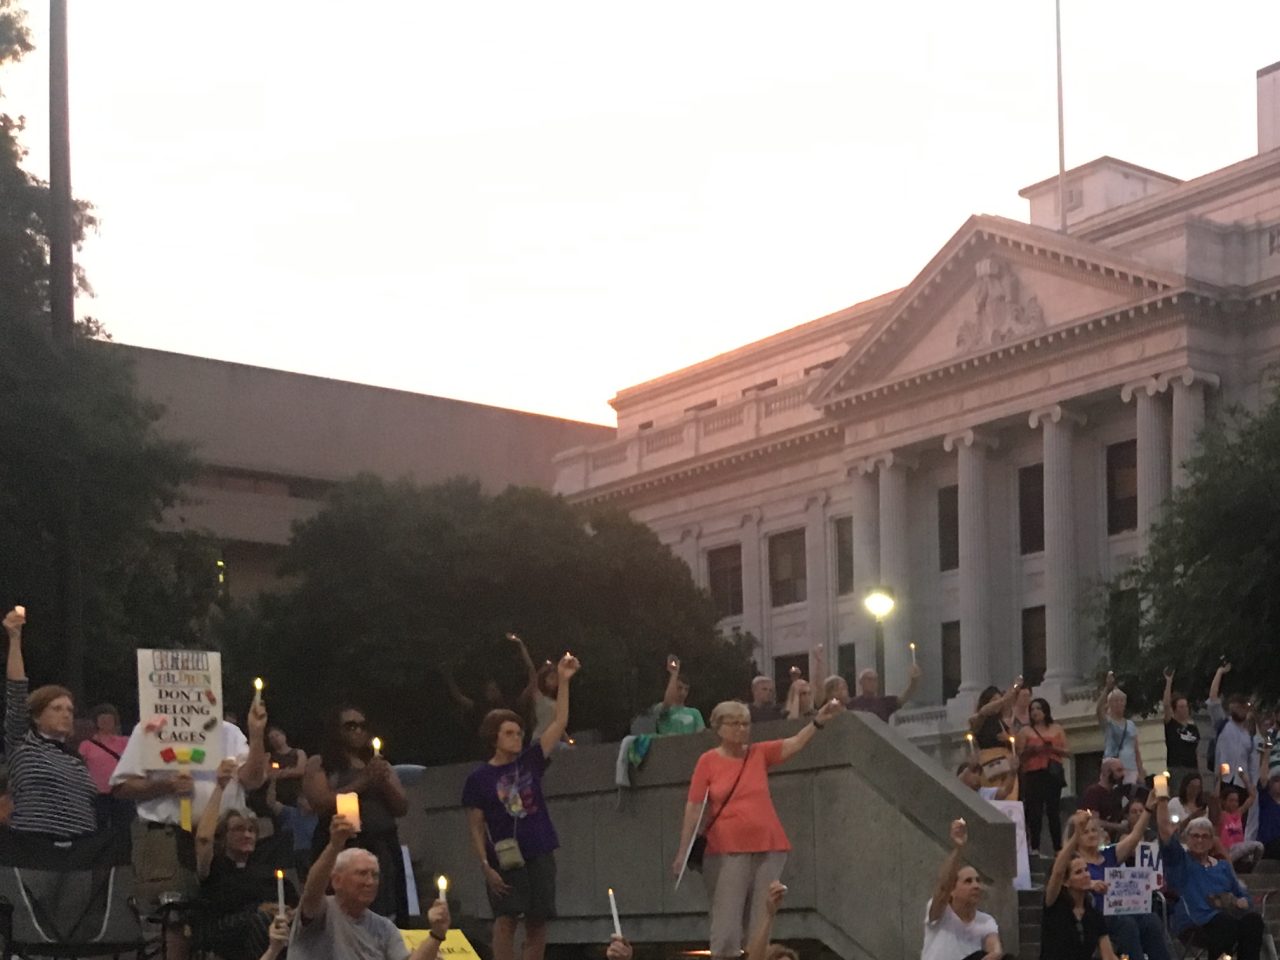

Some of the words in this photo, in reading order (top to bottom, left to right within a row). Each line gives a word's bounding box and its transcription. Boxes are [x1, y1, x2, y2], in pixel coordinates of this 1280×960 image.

[148, 671, 212, 685] CHILDREN
[154, 703, 211, 715] BELONG
[173, 716, 191, 727] IN
[156, 730, 206, 742] CAGES
